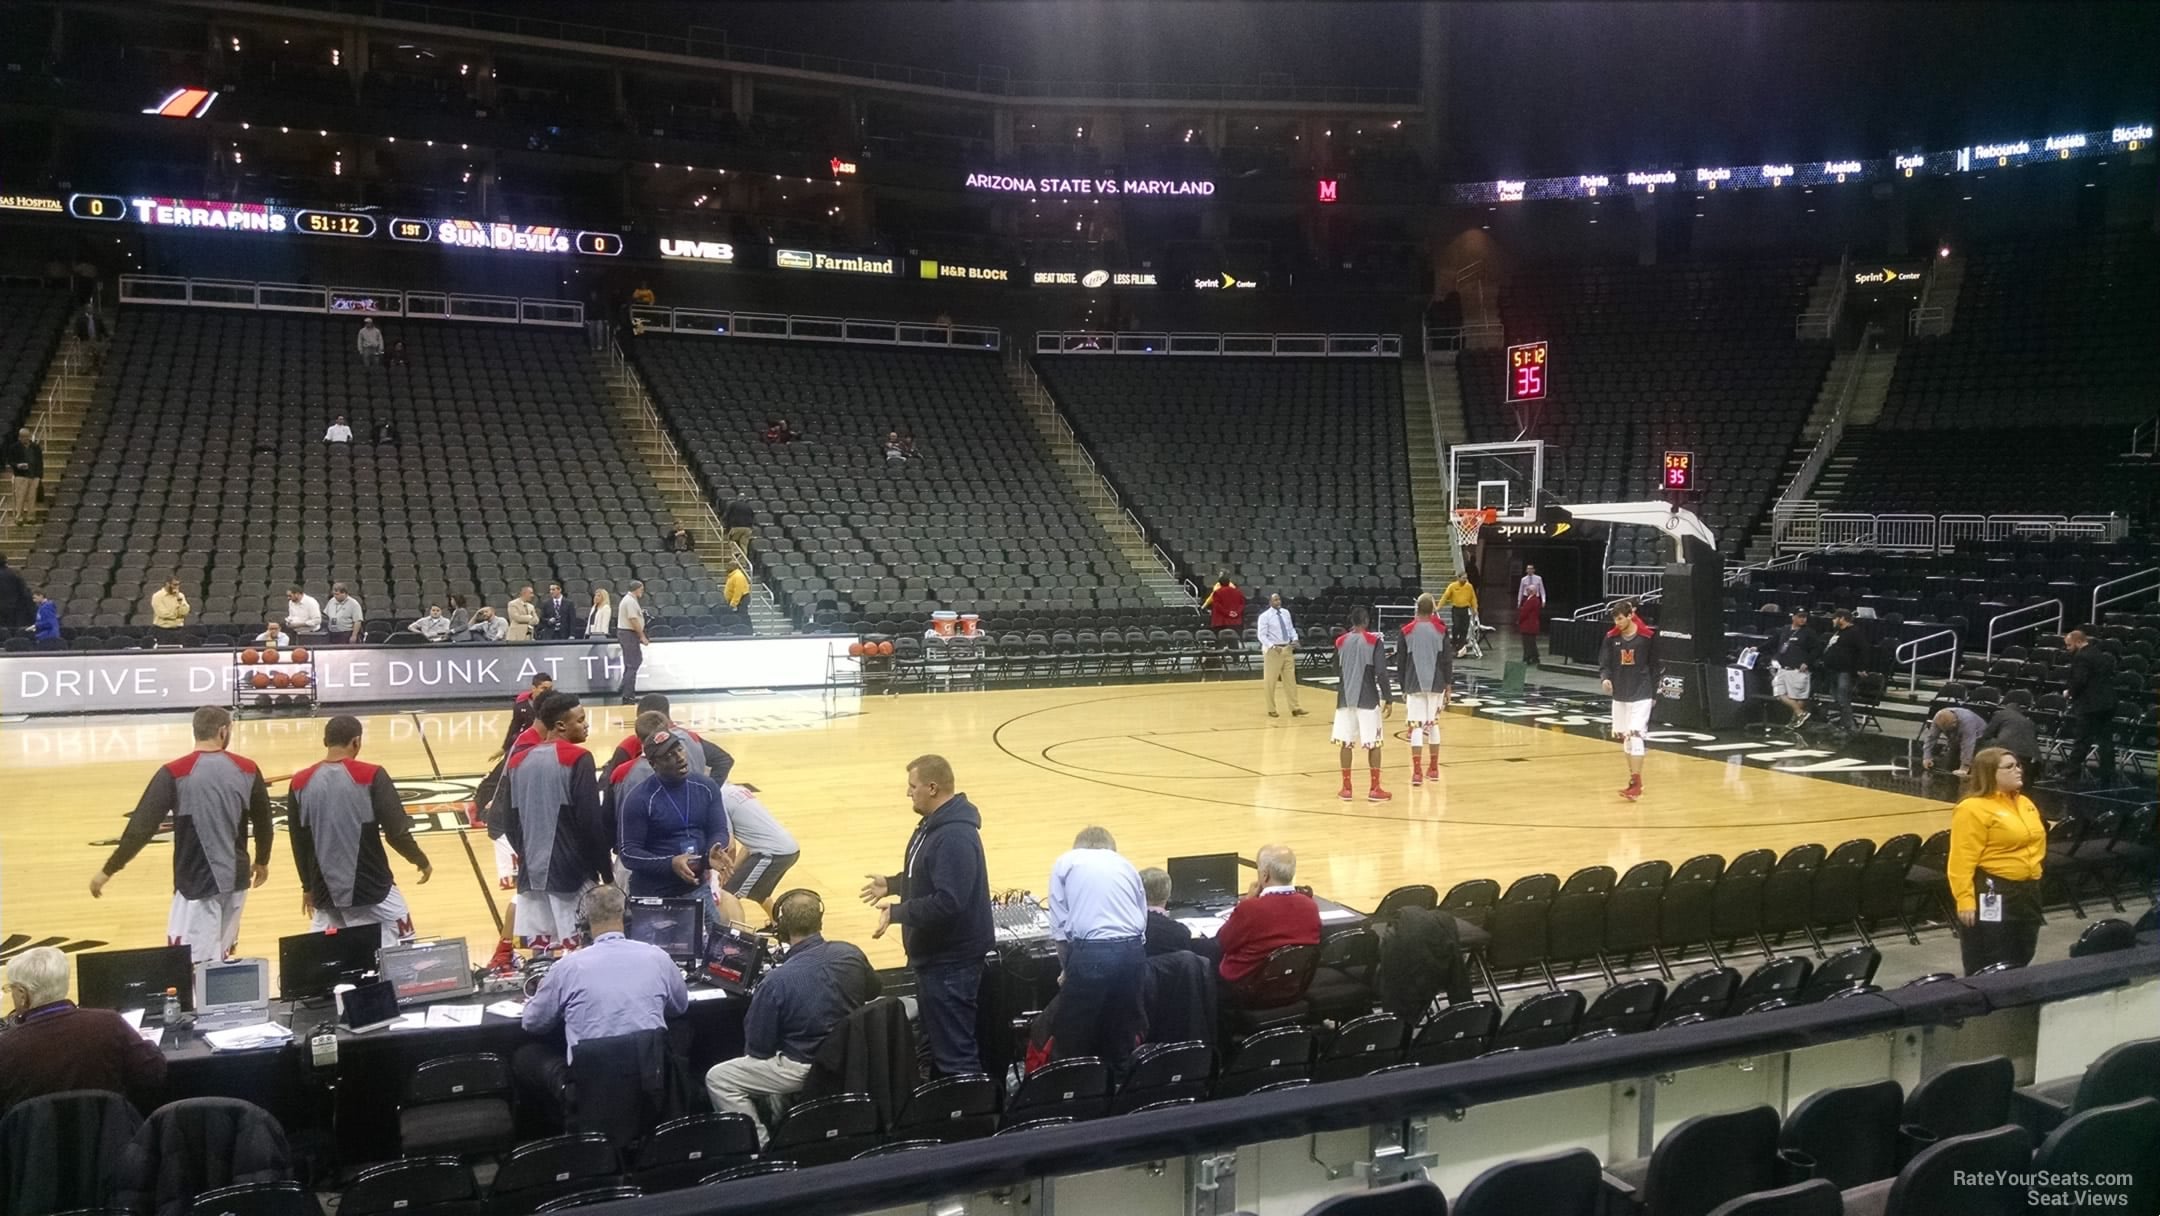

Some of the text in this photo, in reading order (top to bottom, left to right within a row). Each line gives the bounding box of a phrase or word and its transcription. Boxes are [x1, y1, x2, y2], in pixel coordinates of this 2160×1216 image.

[2113, 125, 2152, 142] Blocks
[2045, 134, 2085, 151] Assists
[1975, 141, 2029, 158] Rebounds
[2061, 149, 2068, 159] 0
[1824, 161, 1861, 174] Assists
[1999, 156, 2006, 166] 0
[1697, 167, 1730, 181] Blocks
[1763, 164, 1794, 177] Steals
[1905, 167, 1912, 177] 0
[1580, 176, 1608, 187] Points
[1628, 171, 1676, 184] Rebounds
[1773, 177, 1780, 187] 0
[1838, 173, 1845, 183] 0
[965, 174, 1215, 196] ARIZONA STATE VS. MARYLAND
[1319, 181, 1337, 199] M
[1647, 183, 1654, 193] 0
[1709, 180, 1716, 190] 0
[1589, 187, 1596, 197] 0
[16, 197, 62, 209] HOSPITAL
[91, 199, 103, 216] 0
[133, 199, 287, 231] TERRAPINS
[310, 215, 360, 233] 51:12
[401, 223, 421, 236] 1ST
[439, 224, 569, 252] SUN DEVILS
[594, 238, 605, 251] 0
[659, 238, 735, 260] UMB
[815, 253, 893, 275] Farmland
[941, 265, 1008, 281] H&R BLOCK
[1034, 273, 1078, 284] GREAT TASTE.
[1855, 272, 1921, 285] Sprint Center
[1114, 274, 1158, 286] LESS FILLING.
[1194, 278, 1219, 289] Sprint
[1514, 348, 1545, 367] 51:12
[1518, 366, 1541, 394] 35
[1670, 469, 1685, 484] 35
[1621, 649, 1635, 665] M
[21, 668, 169, 698] DRIVE,
[389, 658, 500, 686] DUNK
[516, 657, 564, 683] AT
[395, 912, 416, 938] M
